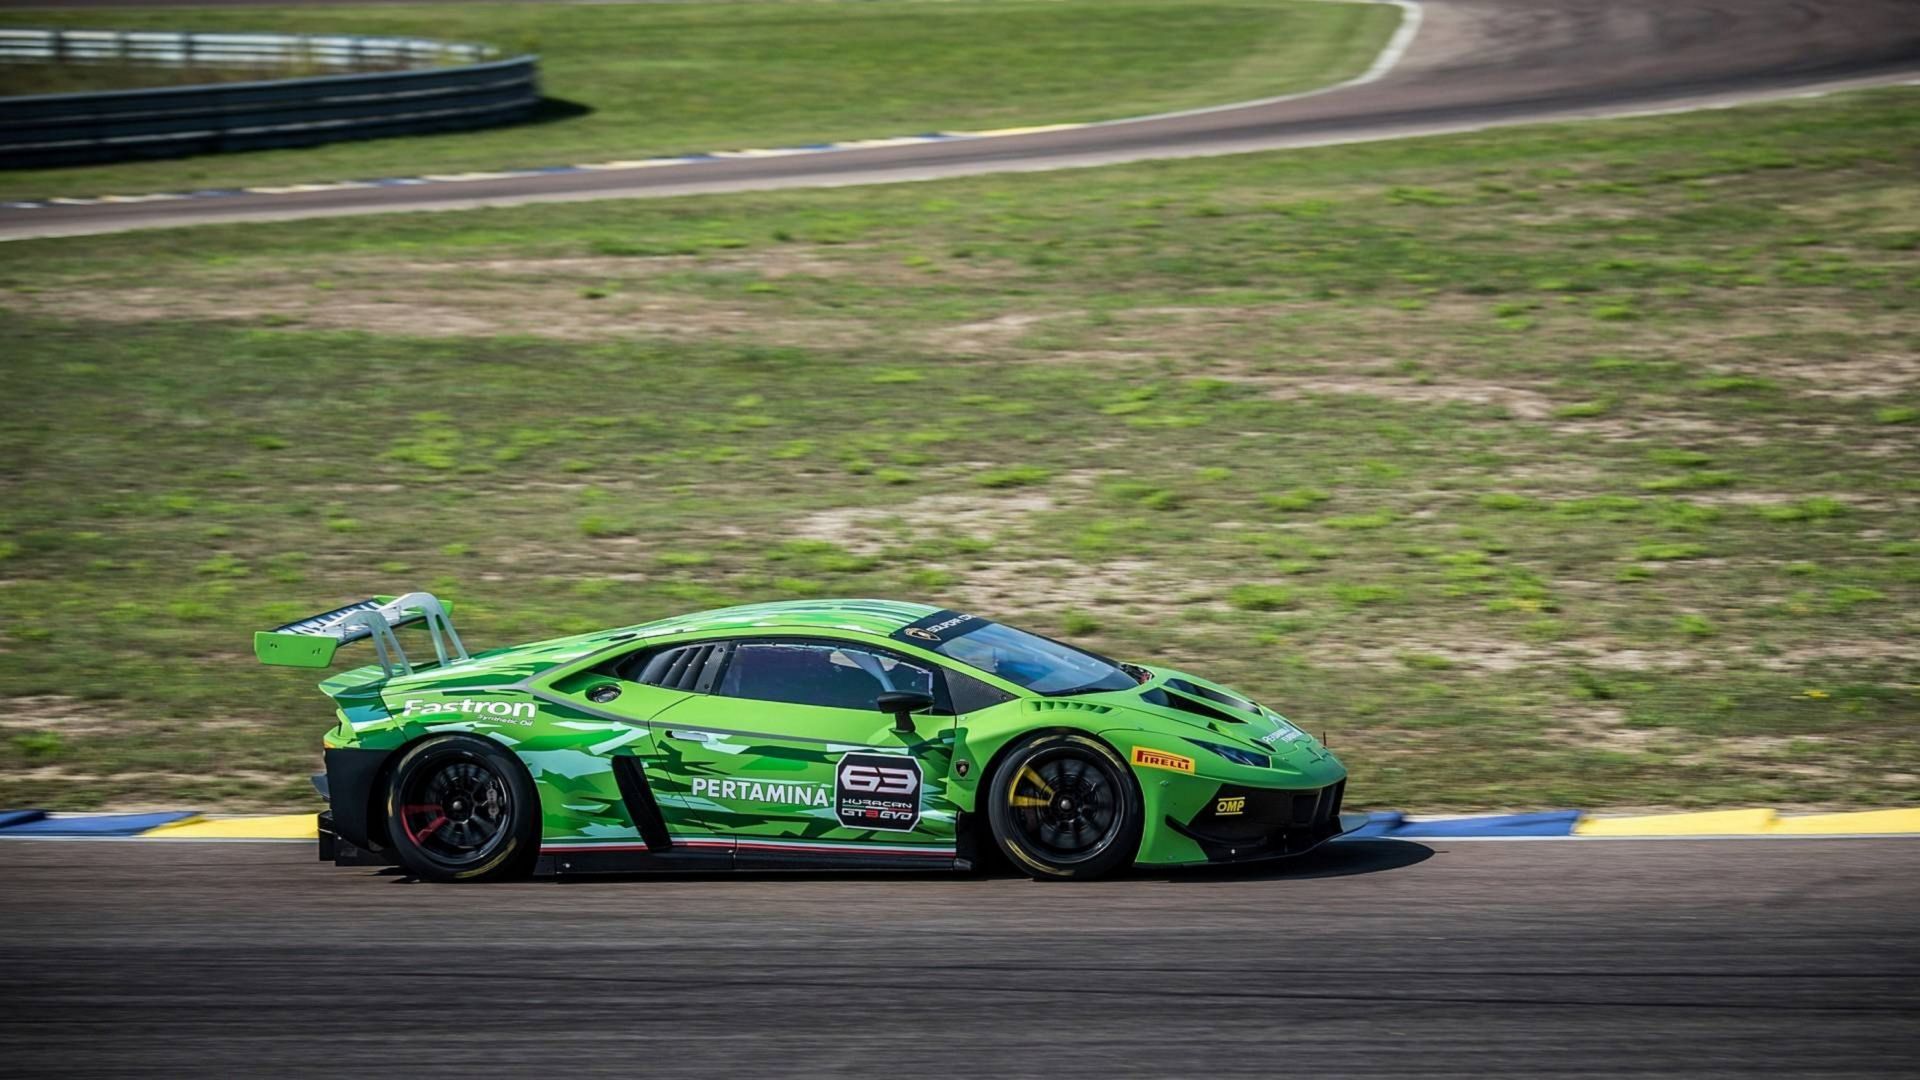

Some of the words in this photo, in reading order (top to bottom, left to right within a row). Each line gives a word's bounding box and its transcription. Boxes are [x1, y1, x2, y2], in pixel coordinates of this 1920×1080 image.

[402, 698, 537, 718] Fastron
[477, 714, 519, 725] Synthetic
[520, 719, 534, 727] Oil
[1136, 750, 1190, 771] PIRELLI
[840, 764, 918, 795] 63
[691, 776, 830, 808] PERTAMINA
[842, 798, 913, 809] HURACAN
[1217, 800, 1245, 812] OMP
